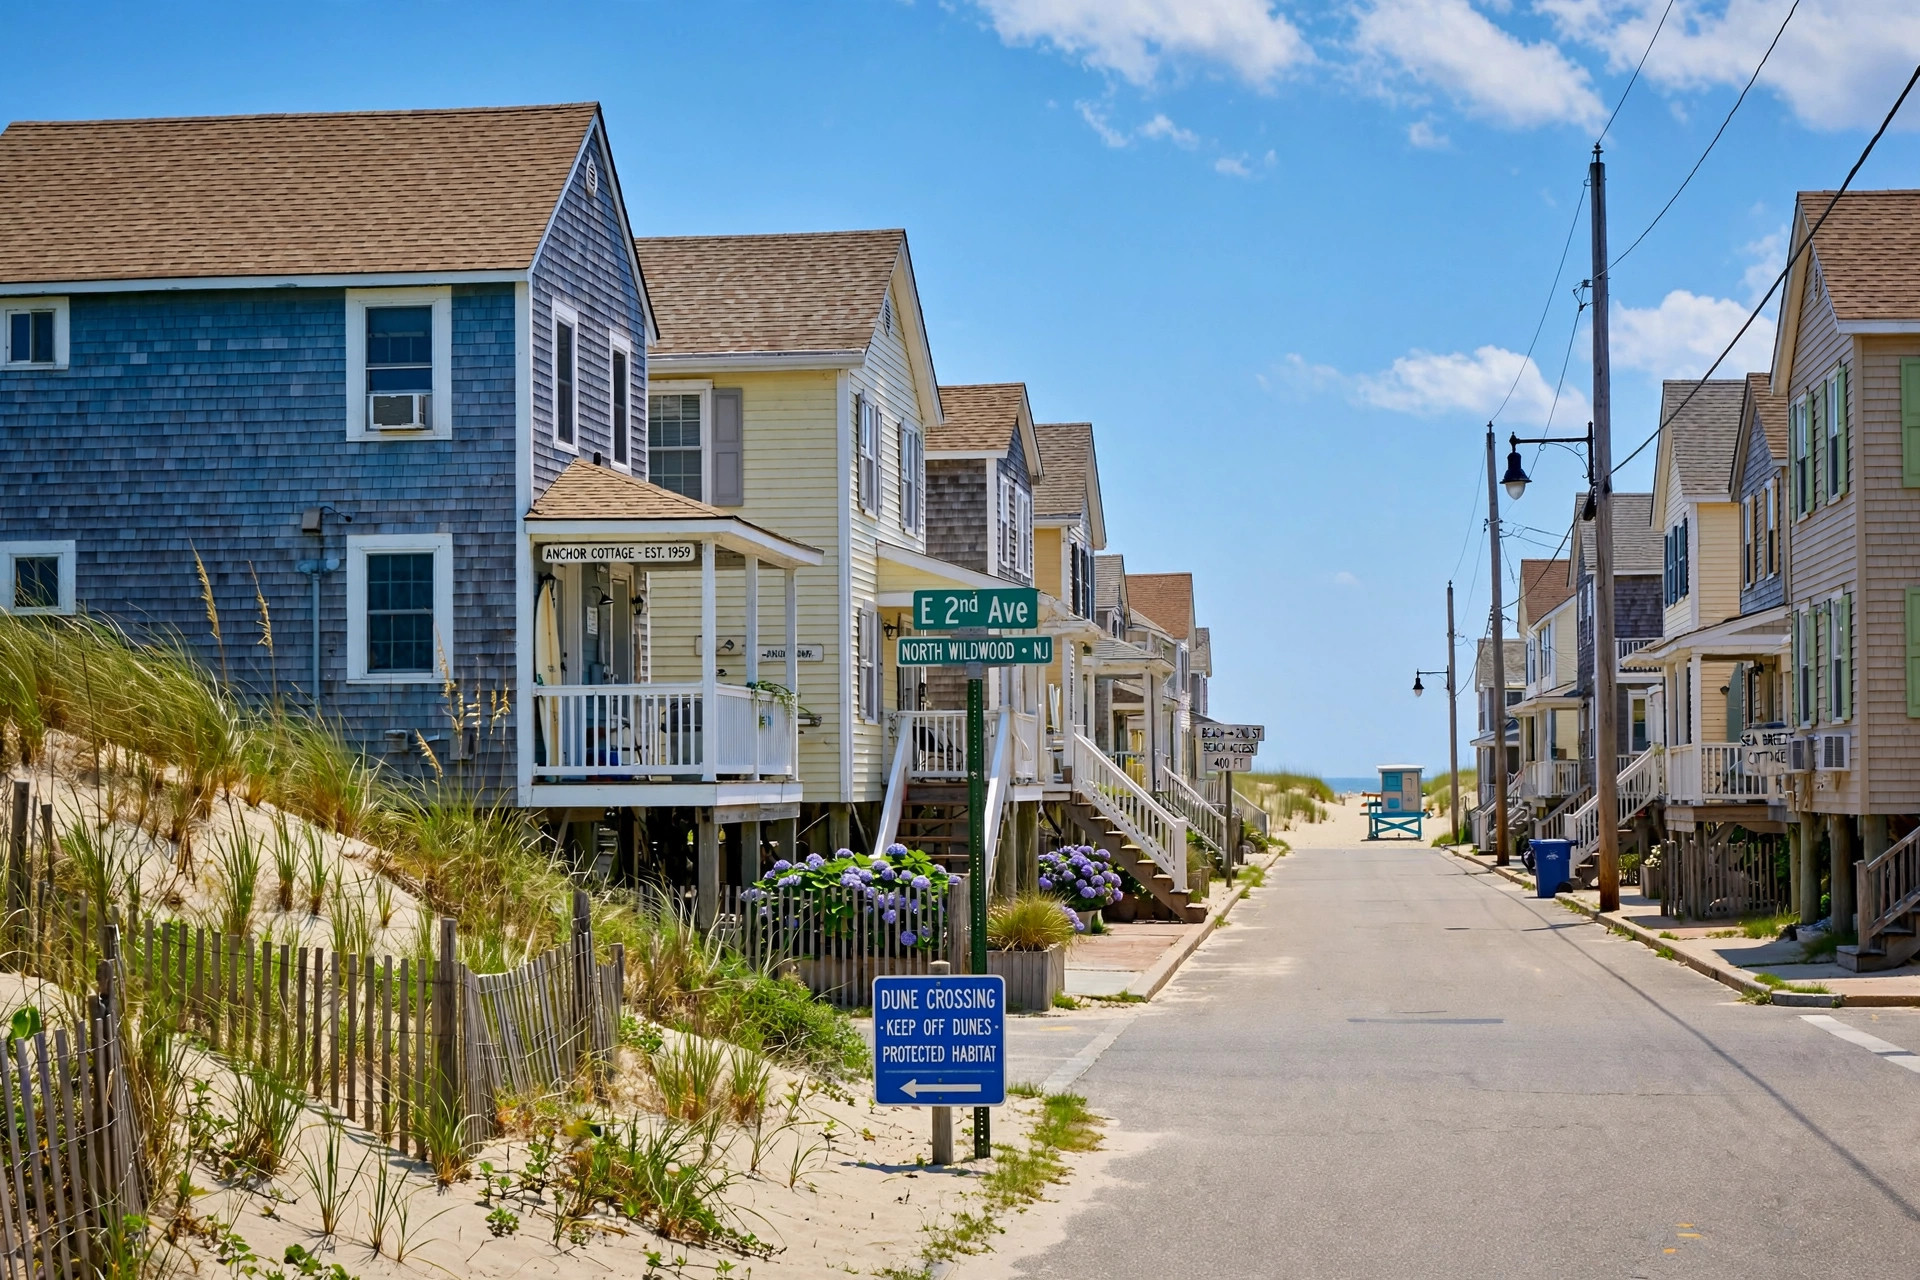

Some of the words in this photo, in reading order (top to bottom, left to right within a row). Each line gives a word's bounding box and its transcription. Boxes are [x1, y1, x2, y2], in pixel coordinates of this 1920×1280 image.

[546, 548, 587, 559] ANCHOR
[591, 547, 634, 559] COTTAGE
[645, 547, 665, 558] EST.
[669, 546, 691, 558] 1959
[921, 597, 934, 624] E
[945, 594, 978, 624] 2nd
[988, 596, 1028, 623] Ave
[902, 643, 942, 661] NORTH
[949, 641, 1015, 660] WILDWOOD
[1034, 642, 1048, 659] NJ
[1233, 757, 1244, 768] FT
[881, 989, 919, 1010] DUNE
[926, 988, 996, 1009] CROSSING
[886, 1019, 916, 1036] KEEP
[923, 1018, 945, 1036] OFF
[952, 1018, 992, 1036] DUNES
[882, 1045, 945, 1063] PROTECTED
[952, 1045, 996, 1063] HABITAT
